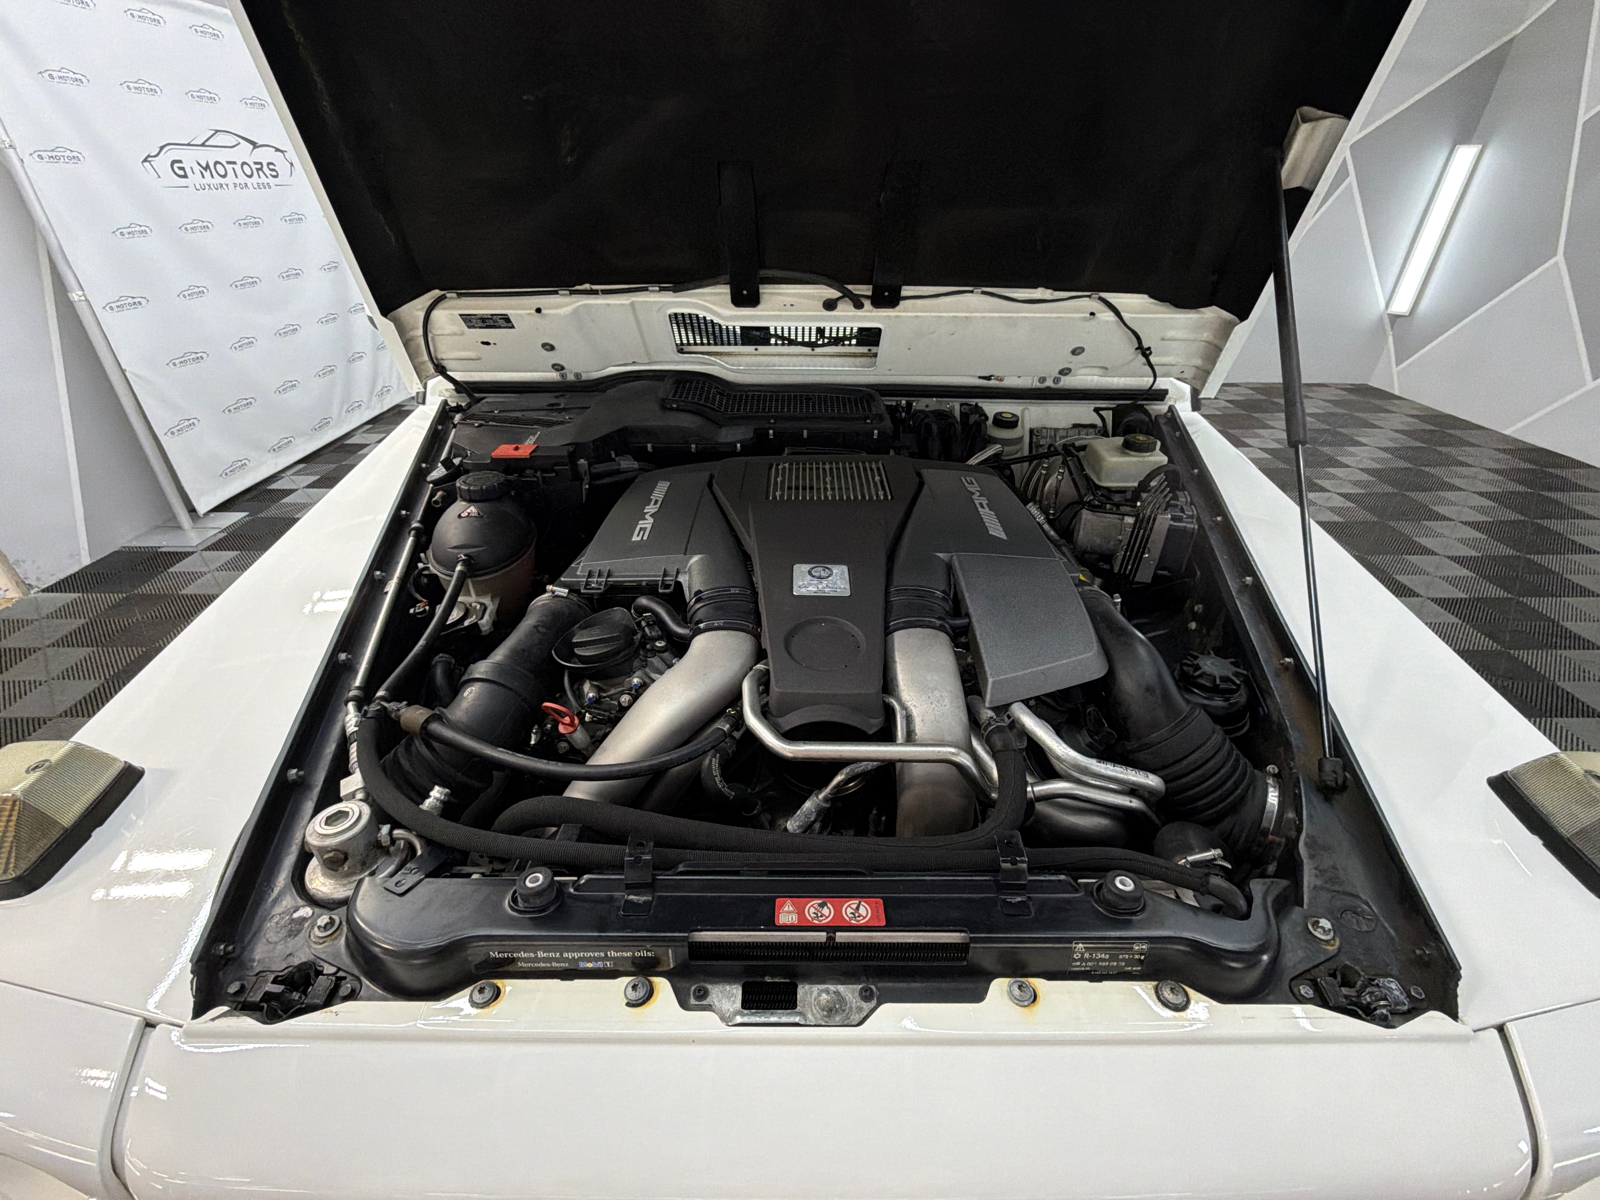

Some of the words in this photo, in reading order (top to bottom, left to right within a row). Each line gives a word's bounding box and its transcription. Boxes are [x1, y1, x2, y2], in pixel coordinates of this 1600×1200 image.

[193, 183, 230, 191] LUXURY
[233, 183, 250, 191] FOR
[251, 182, 272, 190] LESS
[632, 496, 663, 541] AMG
[490, 951, 561, 959] Mercedes-Benz
[563, 951, 605, 960] approves
[607, 950, 633, 958] these
